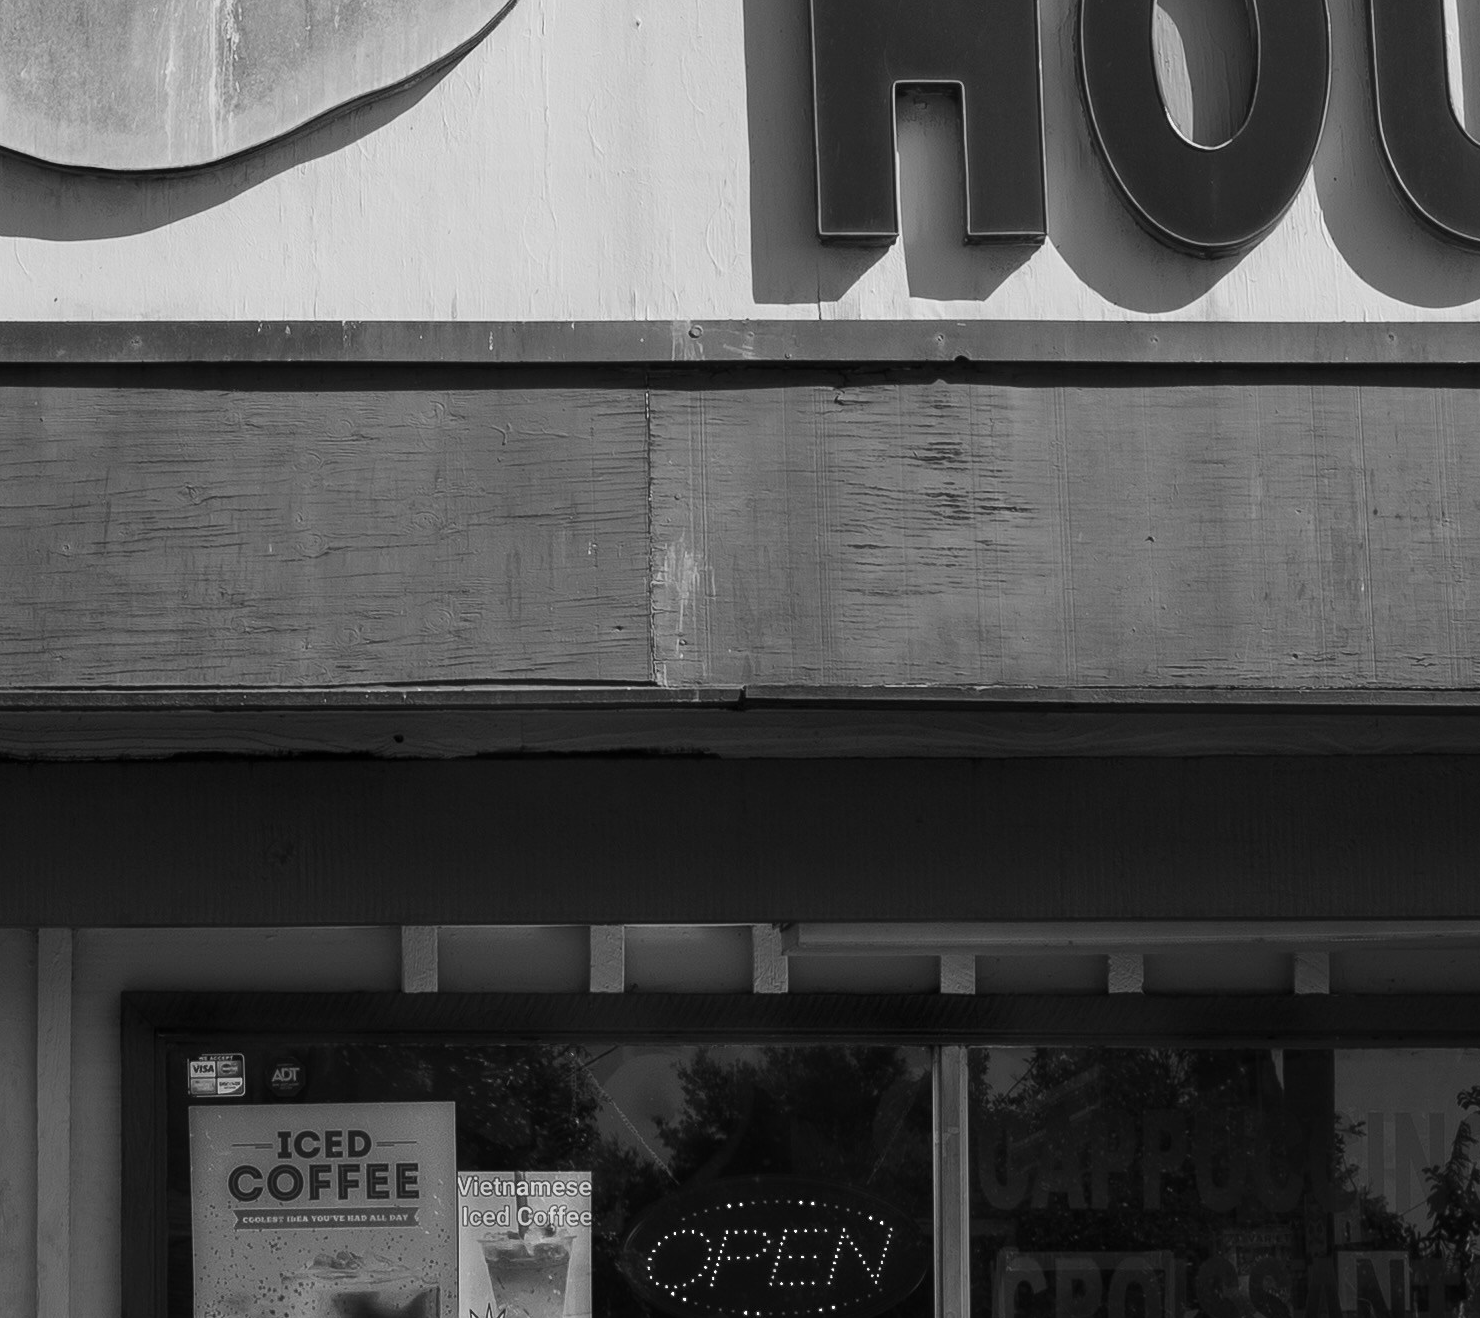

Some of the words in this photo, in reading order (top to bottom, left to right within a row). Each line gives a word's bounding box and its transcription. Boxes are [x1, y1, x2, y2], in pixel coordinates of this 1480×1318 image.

[192, 1064, 215, 1074] VISA
[271, 1067, 300, 1082] ADT
[276, 1129, 373, 1160] ICED
[227, 1162, 420, 1203] COFFEE
[457, 1175, 593, 1198] Vietnamese
[241, 1215, 285, 1224] COOLEST
[286, 1215, 309, 1223] IDEA
[311, 1214, 345, 1223] YOU'VE
[346, 1213, 368, 1222] HAD
[369, 1213, 388, 1222] ALL
[389, 1213, 409, 1222] DAY
[462, 1204, 511, 1227] Iced
[517, 1204, 593, 1227] Coffee
[646, 1227, 895, 1289] OPEN
